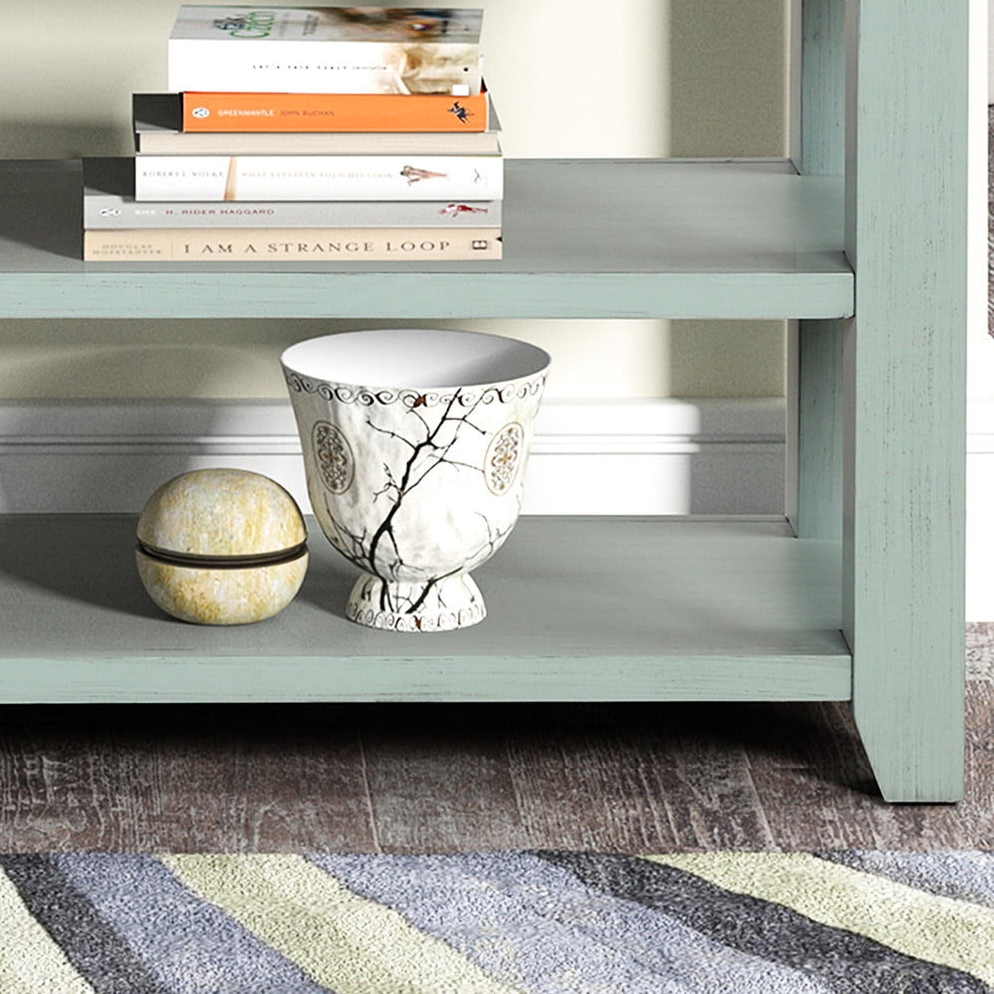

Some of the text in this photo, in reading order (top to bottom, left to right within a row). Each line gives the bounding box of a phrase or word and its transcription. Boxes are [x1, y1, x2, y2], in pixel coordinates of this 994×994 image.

[217, 109, 274, 117] GREENMANTLE
[185, 242, 450, 253] I AM A STRANGE LOOP
